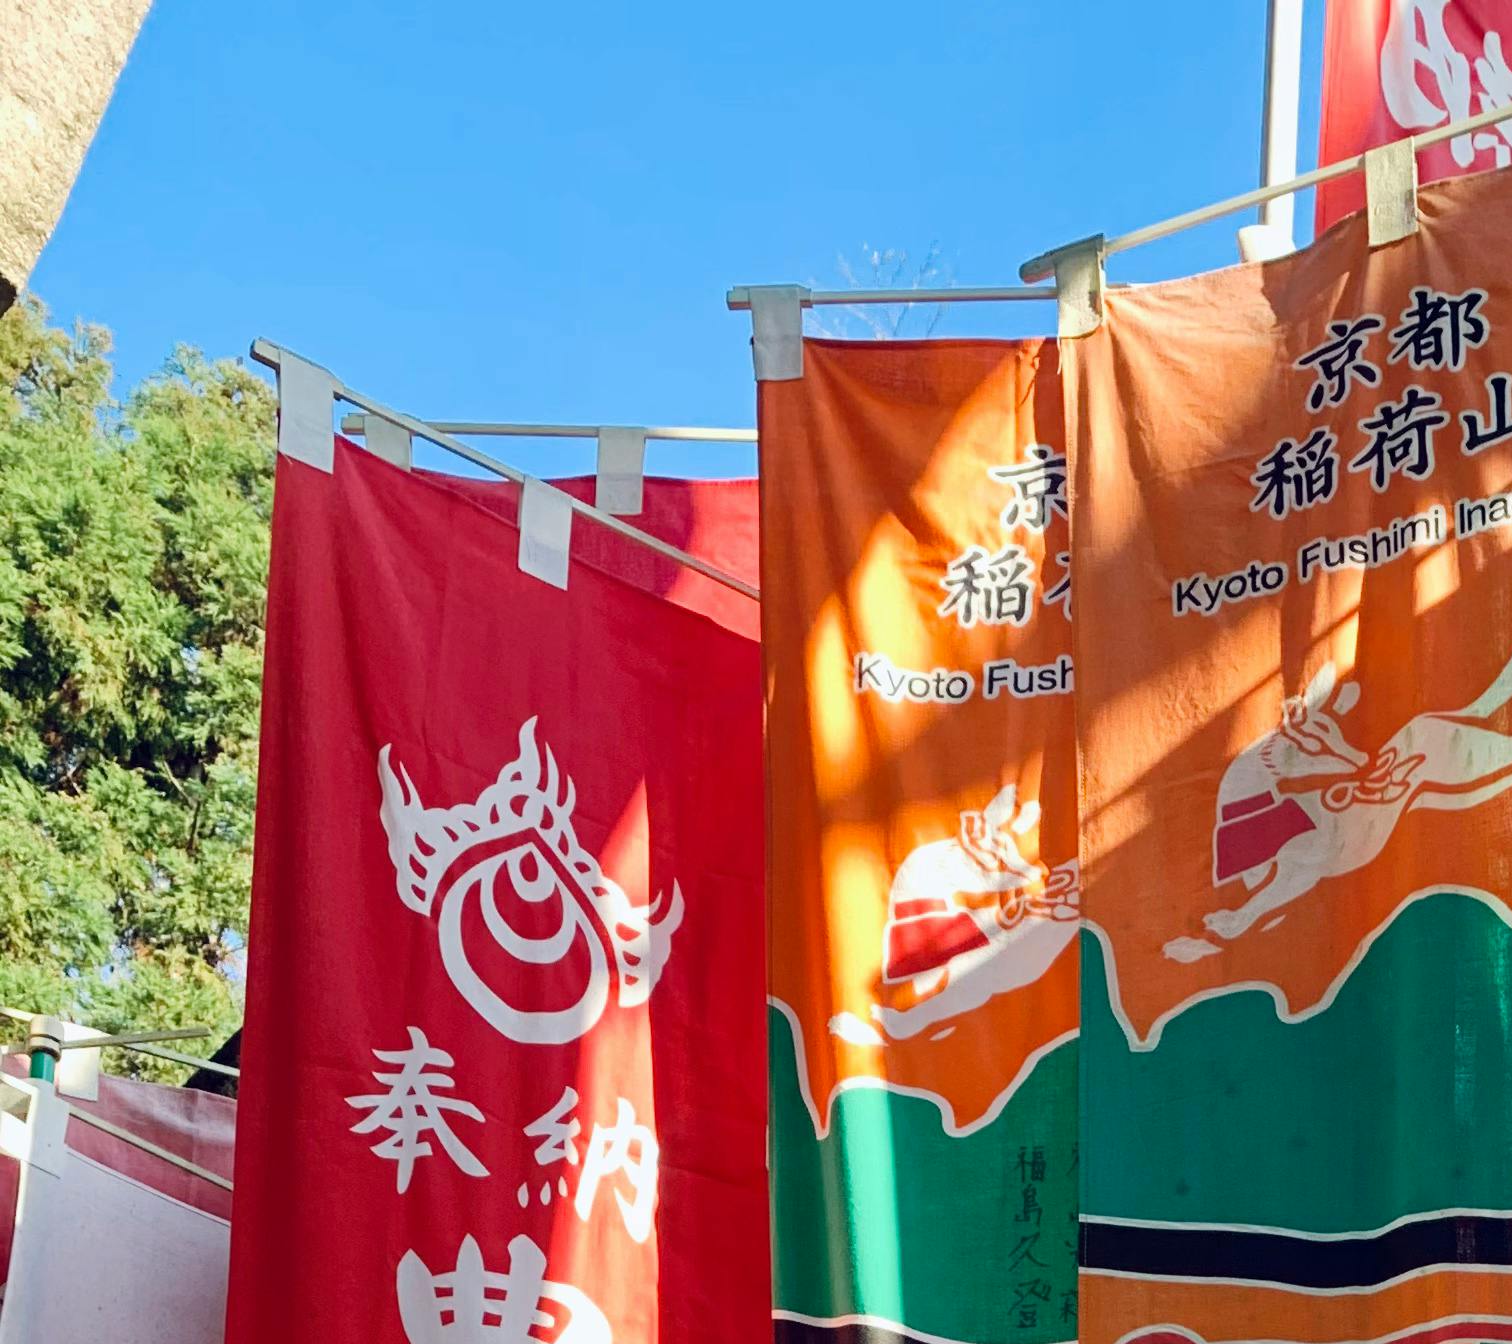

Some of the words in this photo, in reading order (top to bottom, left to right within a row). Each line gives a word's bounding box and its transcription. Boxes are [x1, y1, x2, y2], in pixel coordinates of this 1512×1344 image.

[1298, 291, 1487, 408] 京都
[1174, 562, 1285, 613] Kyoto
[1300, 510, 1442, 579] Fushimi
[857, 656, 968, 699] Kyoto
[344, 1025, 660, 1244] 奉納
